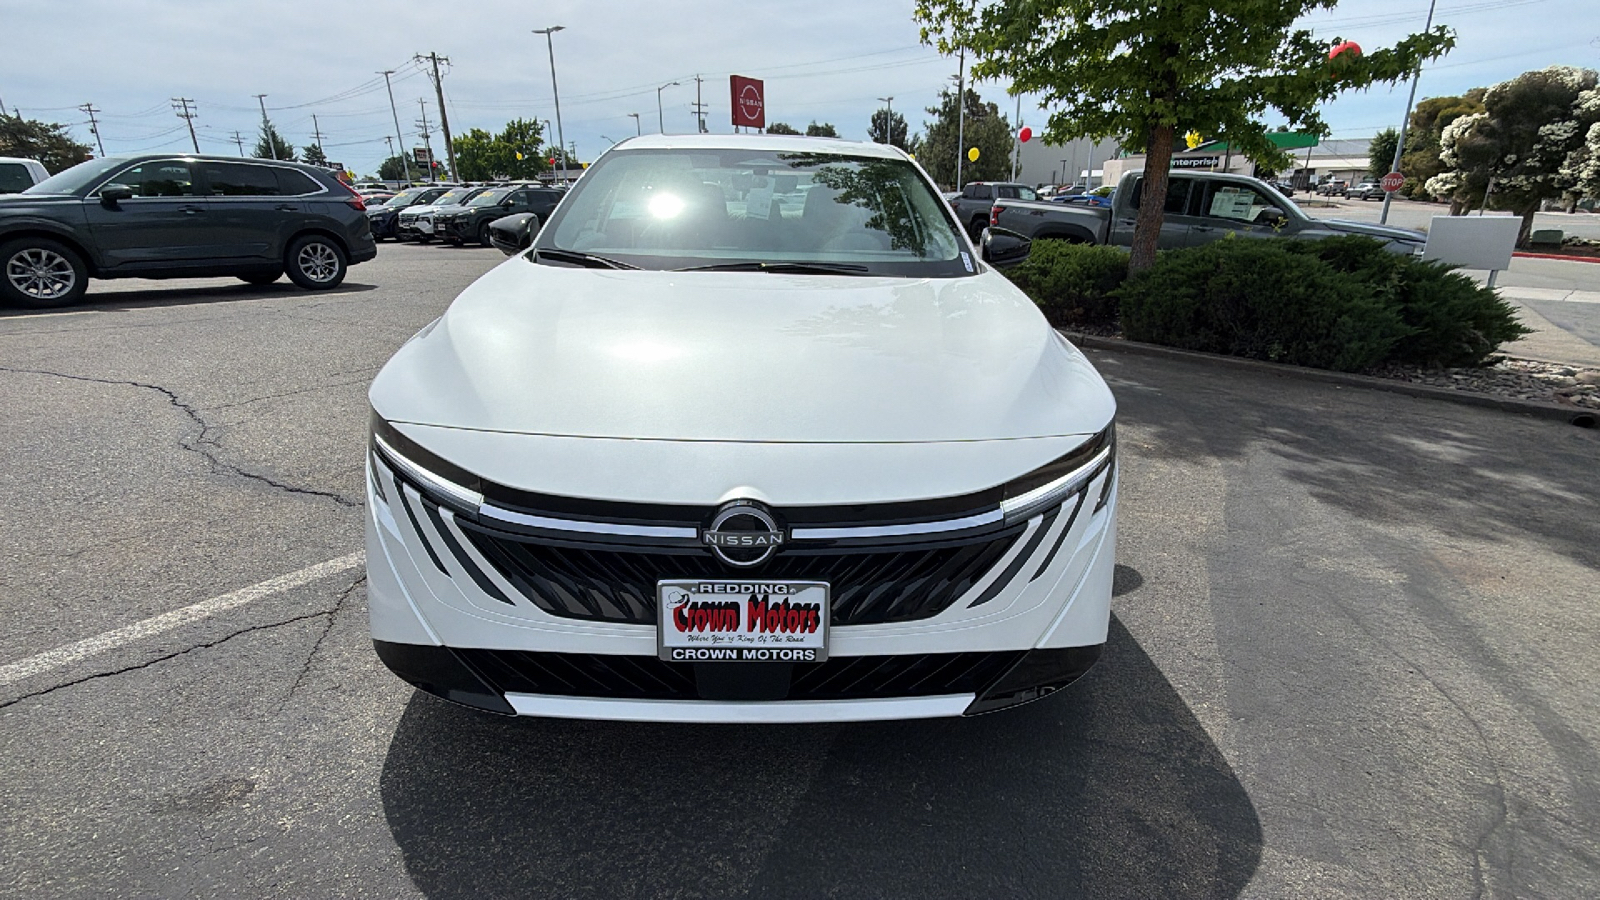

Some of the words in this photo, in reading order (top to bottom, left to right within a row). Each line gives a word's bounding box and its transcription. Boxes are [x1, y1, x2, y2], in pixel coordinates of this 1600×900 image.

[1382, 178, 1402, 186] STOP
[706, 534, 782, 545] NISSAN
[700, 584, 788, 594] REDDING
[673, 594, 740, 632] Crown
[747, 594, 820, 633] Motors
[687, 635, 709, 643] Where
[711, 634, 735, 645] You're
[738, 634, 755, 644] King
[757, 635, 767, 644] Of
[770, 634, 784, 643] The
[672, 649, 737, 660] CROWN
[742, 649, 815, 660] MOTORS
